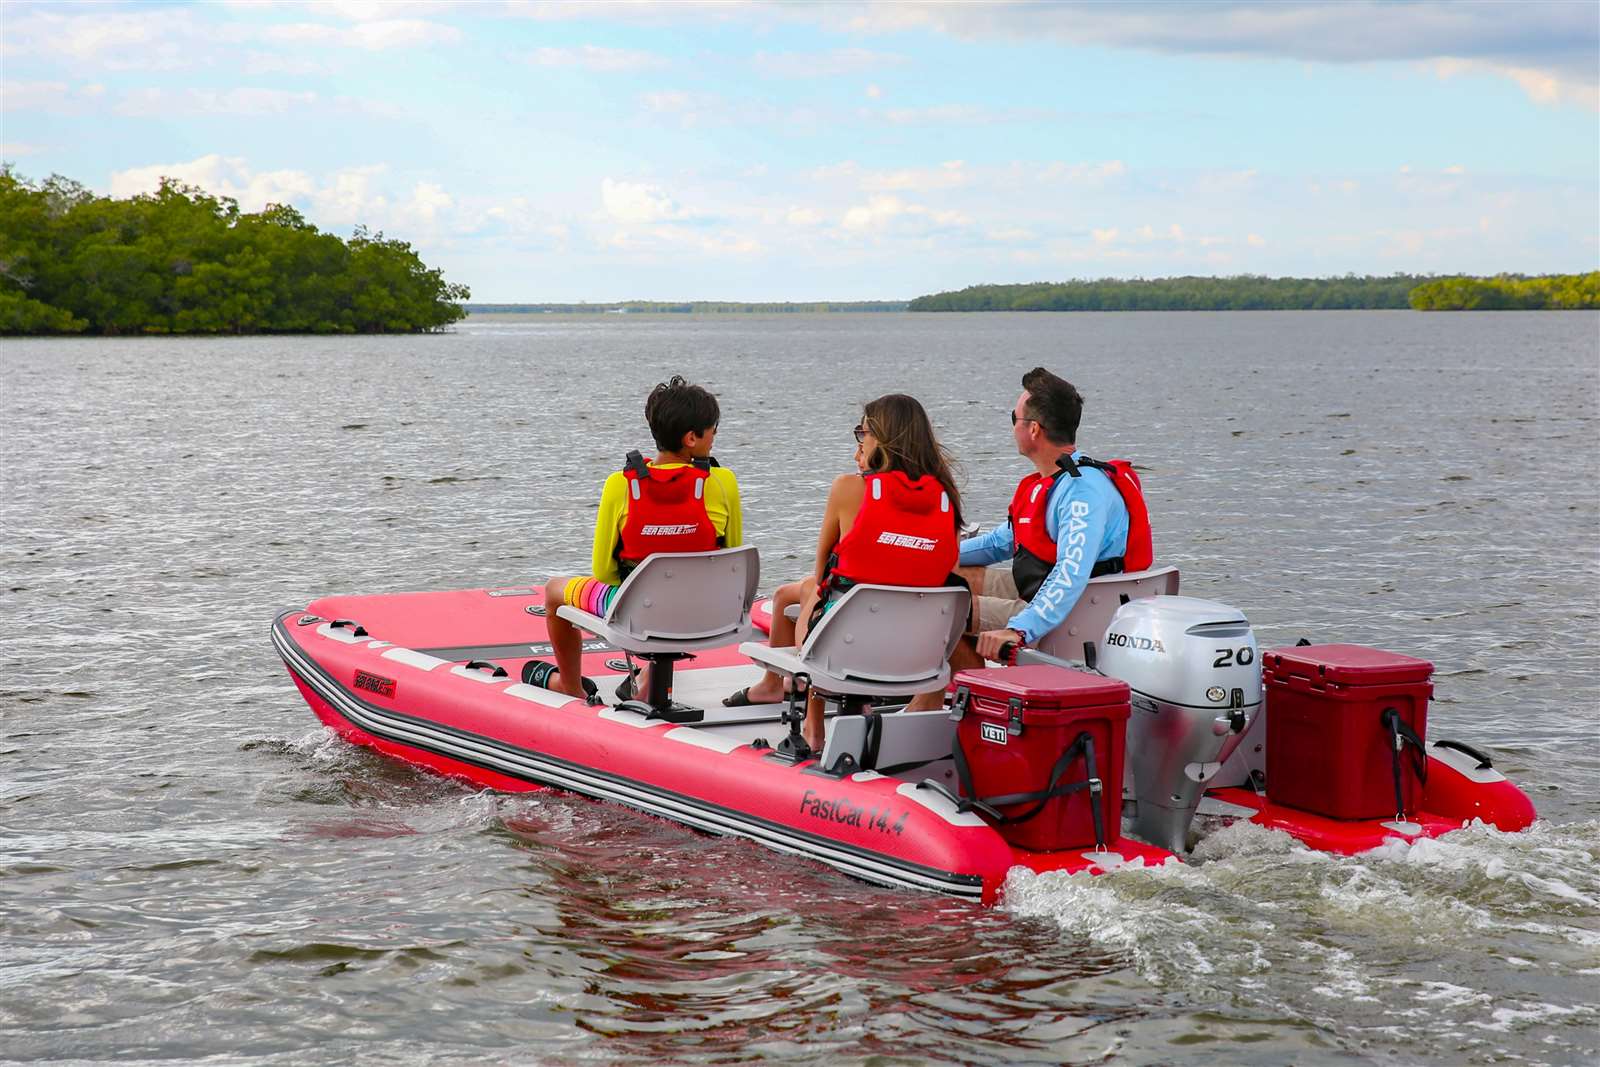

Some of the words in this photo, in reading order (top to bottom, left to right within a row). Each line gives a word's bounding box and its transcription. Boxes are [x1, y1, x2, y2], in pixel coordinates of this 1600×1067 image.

[1107, 632, 1166, 653] HONDA
[1213, 646, 1254, 668] 20
[983, 725, 1005, 741] YETI
[799, 789, 865, 828] FastCat
[867, 806, 910, 836] 14.4
